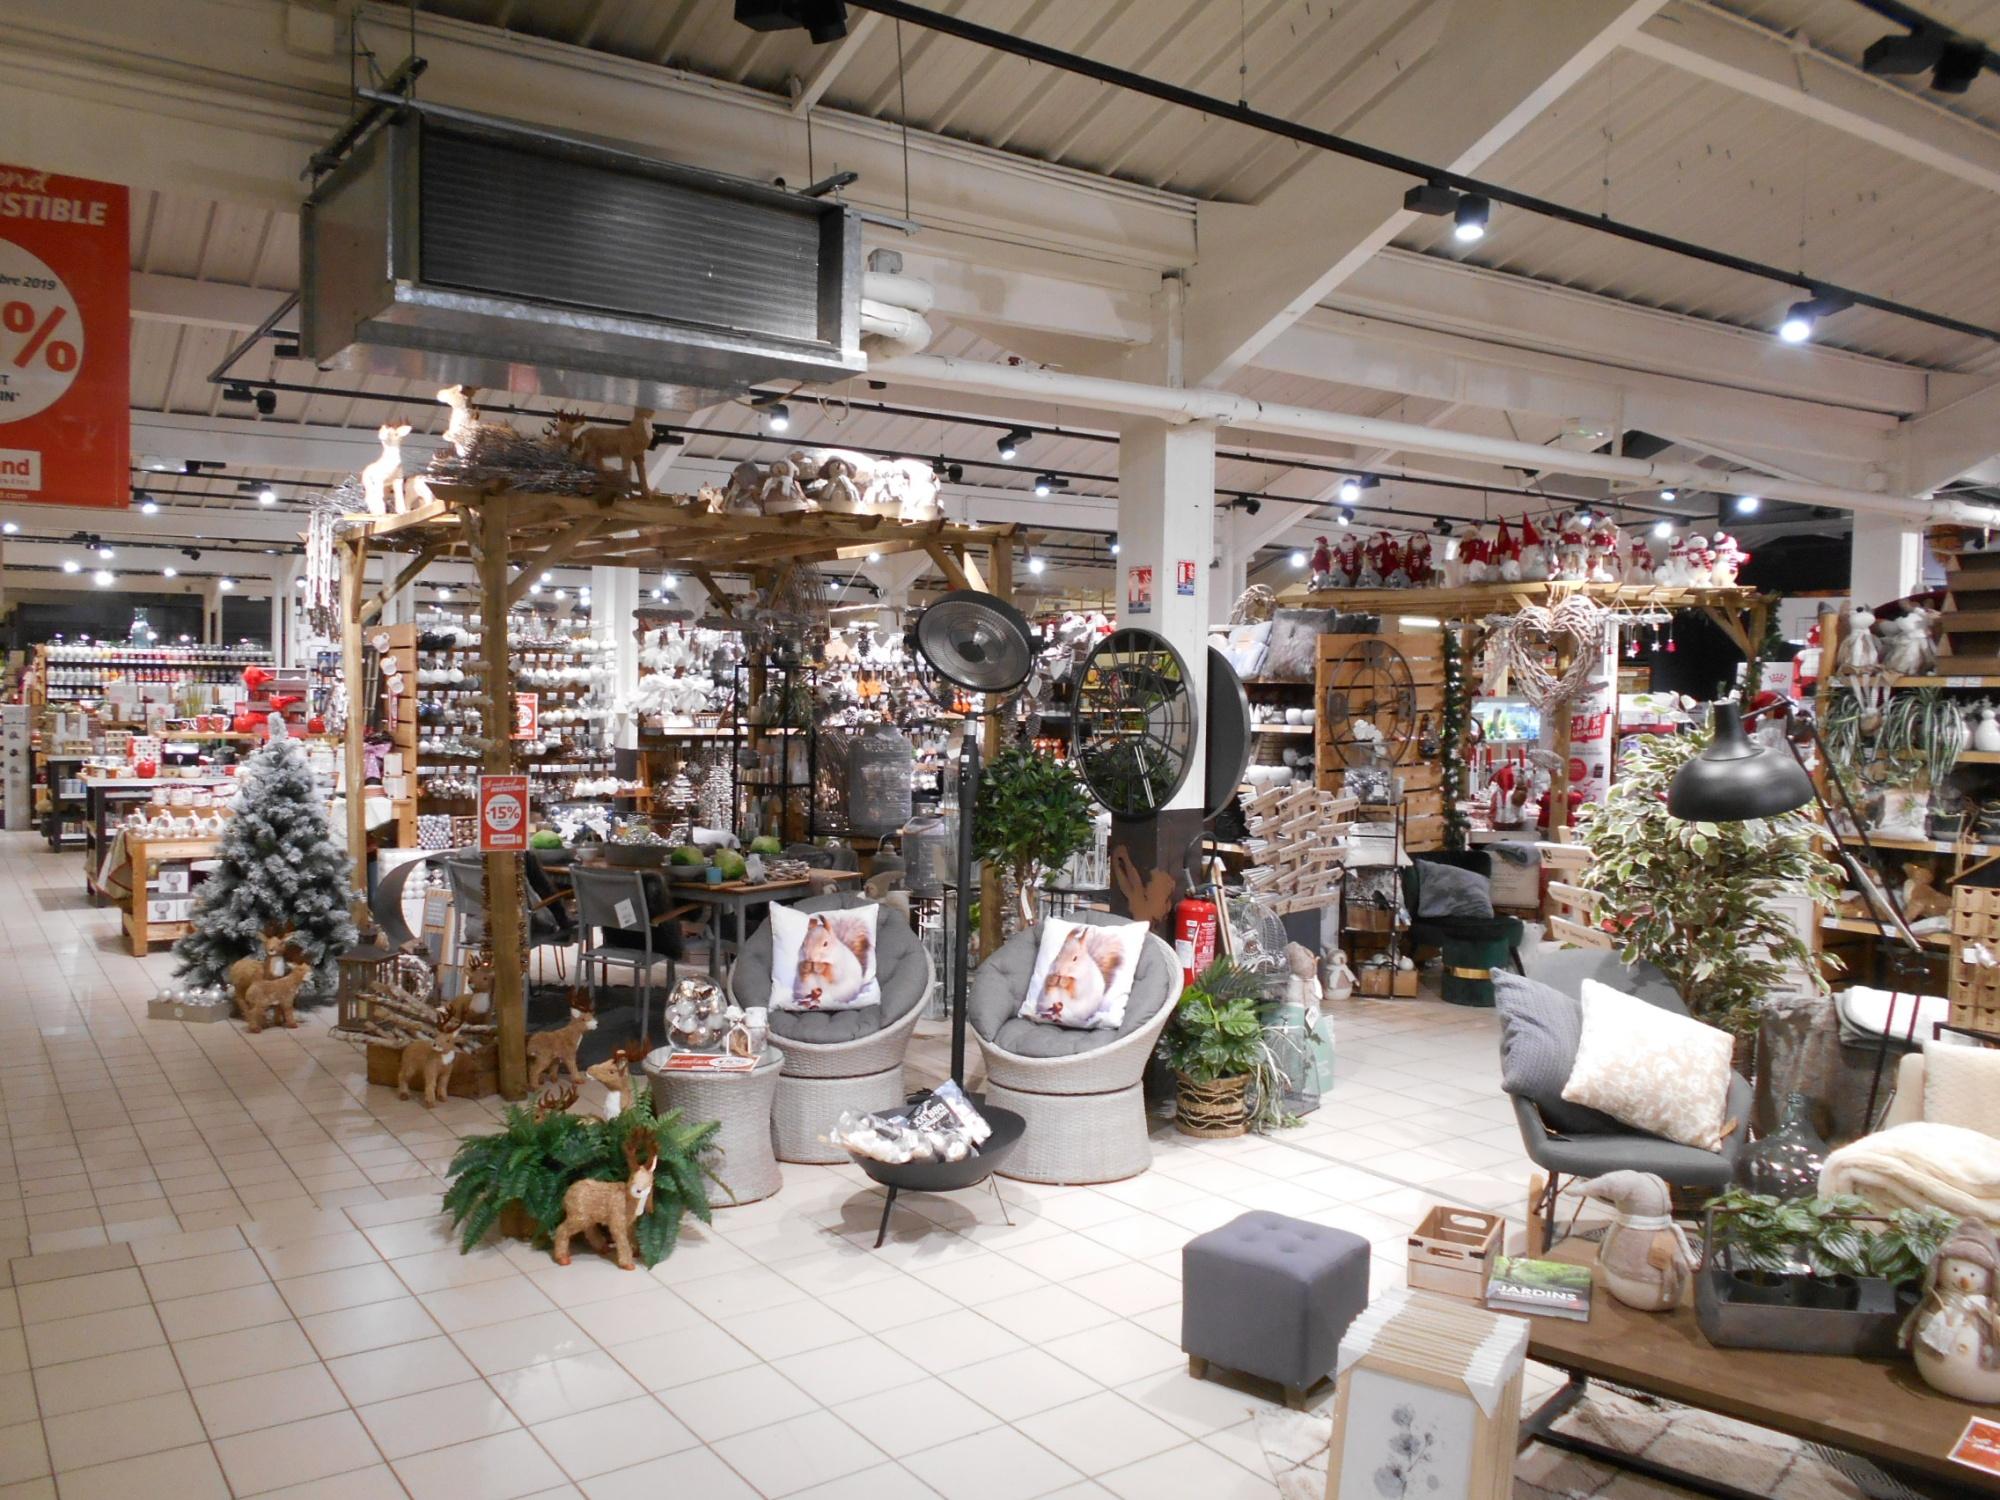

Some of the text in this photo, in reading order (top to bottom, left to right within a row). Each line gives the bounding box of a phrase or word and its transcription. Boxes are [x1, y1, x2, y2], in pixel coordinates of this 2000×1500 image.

[23, 276, 56, 290] 2019
[486, 806, 520, 820] -15%
[1497, 1285, 1577, 1301] JARDINS
